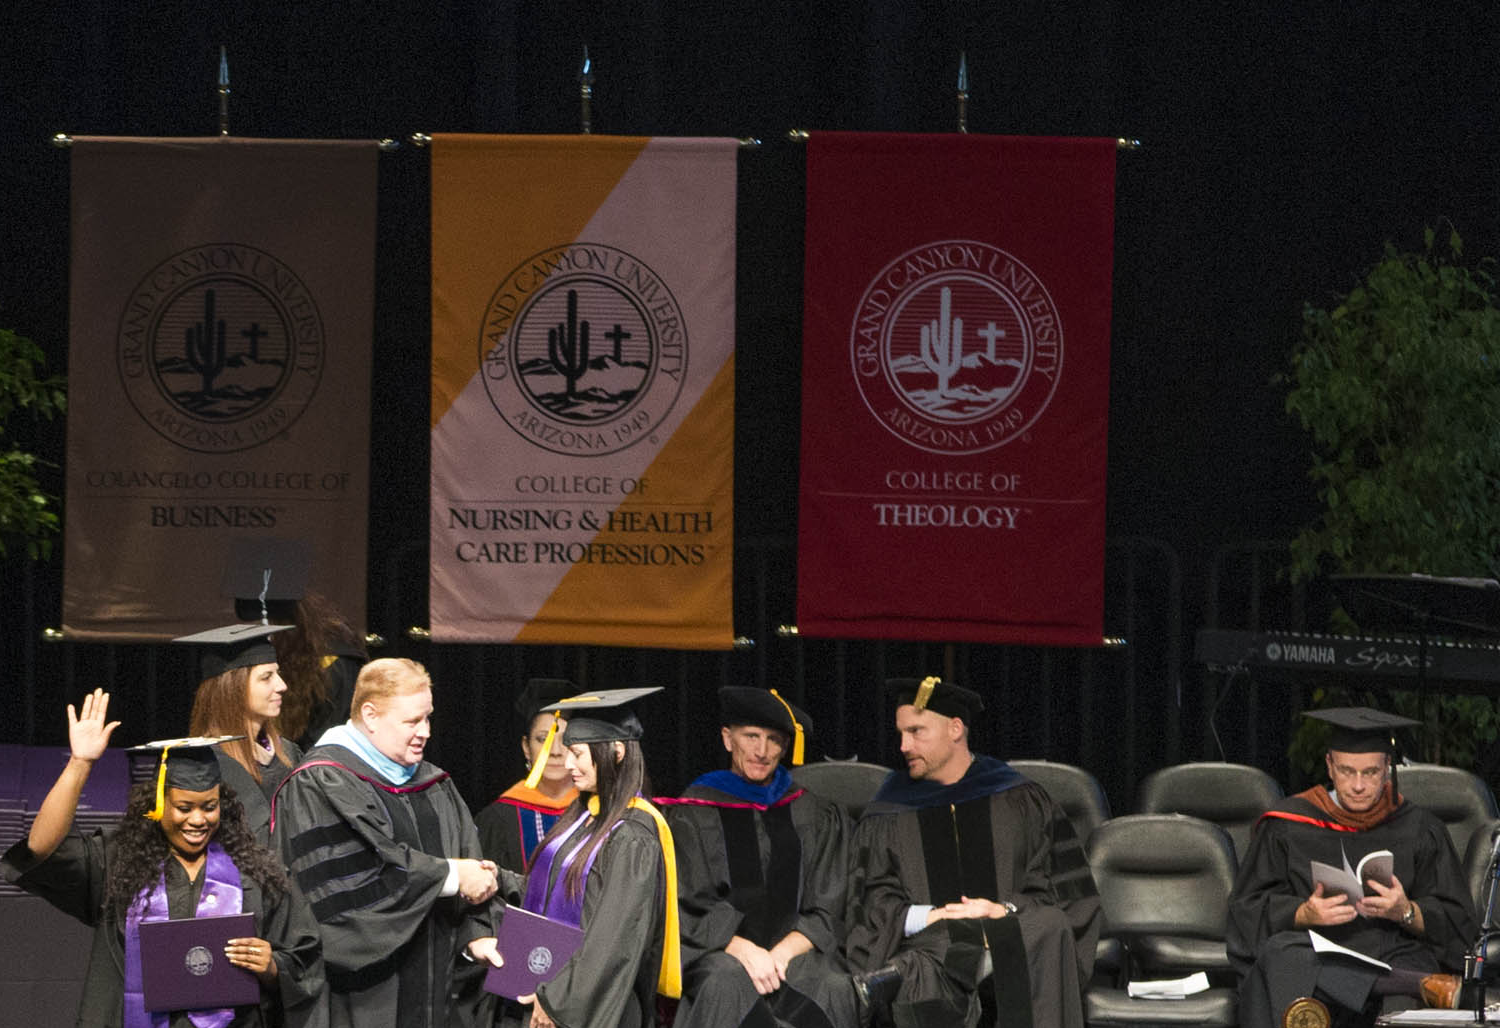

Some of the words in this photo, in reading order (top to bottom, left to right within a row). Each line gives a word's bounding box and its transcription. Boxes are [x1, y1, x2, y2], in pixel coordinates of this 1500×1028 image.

[486, 294, 518, 381] GRAND
[514, 247, 608, 293] CANYON
[614, 256, 683, 382] UNIVERSITY
[857, 290, 891, 377] GRAND
[888, 245, 983, 291] CANYON
[988, 254, 1058, 381] UNIVERSITY
[513, 411, 608, 449] ARIZONA
[613, 410, 651, 442] 1949
[883, 407, 980, 446] ARIZONA
[986, 407, 1023, 440] 1949
[85, 471, 212, 489] COLANGELO
[218, 471, 313, 490] COLLEGE
[321, 472, 351, 490] OF
[515, 475, 612, 494] COLLEGE
[620, 477, 649, 495] OF
[885, 470, 983, 490] COLLEGE
[991, 474, 1021, 492] OF
[151, 505, 277, 528] BUSINESS
[448, 507, 573, 531] NURSING
[579, 510, 600, 531] &
[606, 511, 714, 533] HEALTH
[873, 503, 1020, 529] THEOLOGY
[456, 542, 528, 563] CARE
[533, 542, 705, 565] PROFESSIONS
[1283, 644, 1335, 664] YAMAHA
